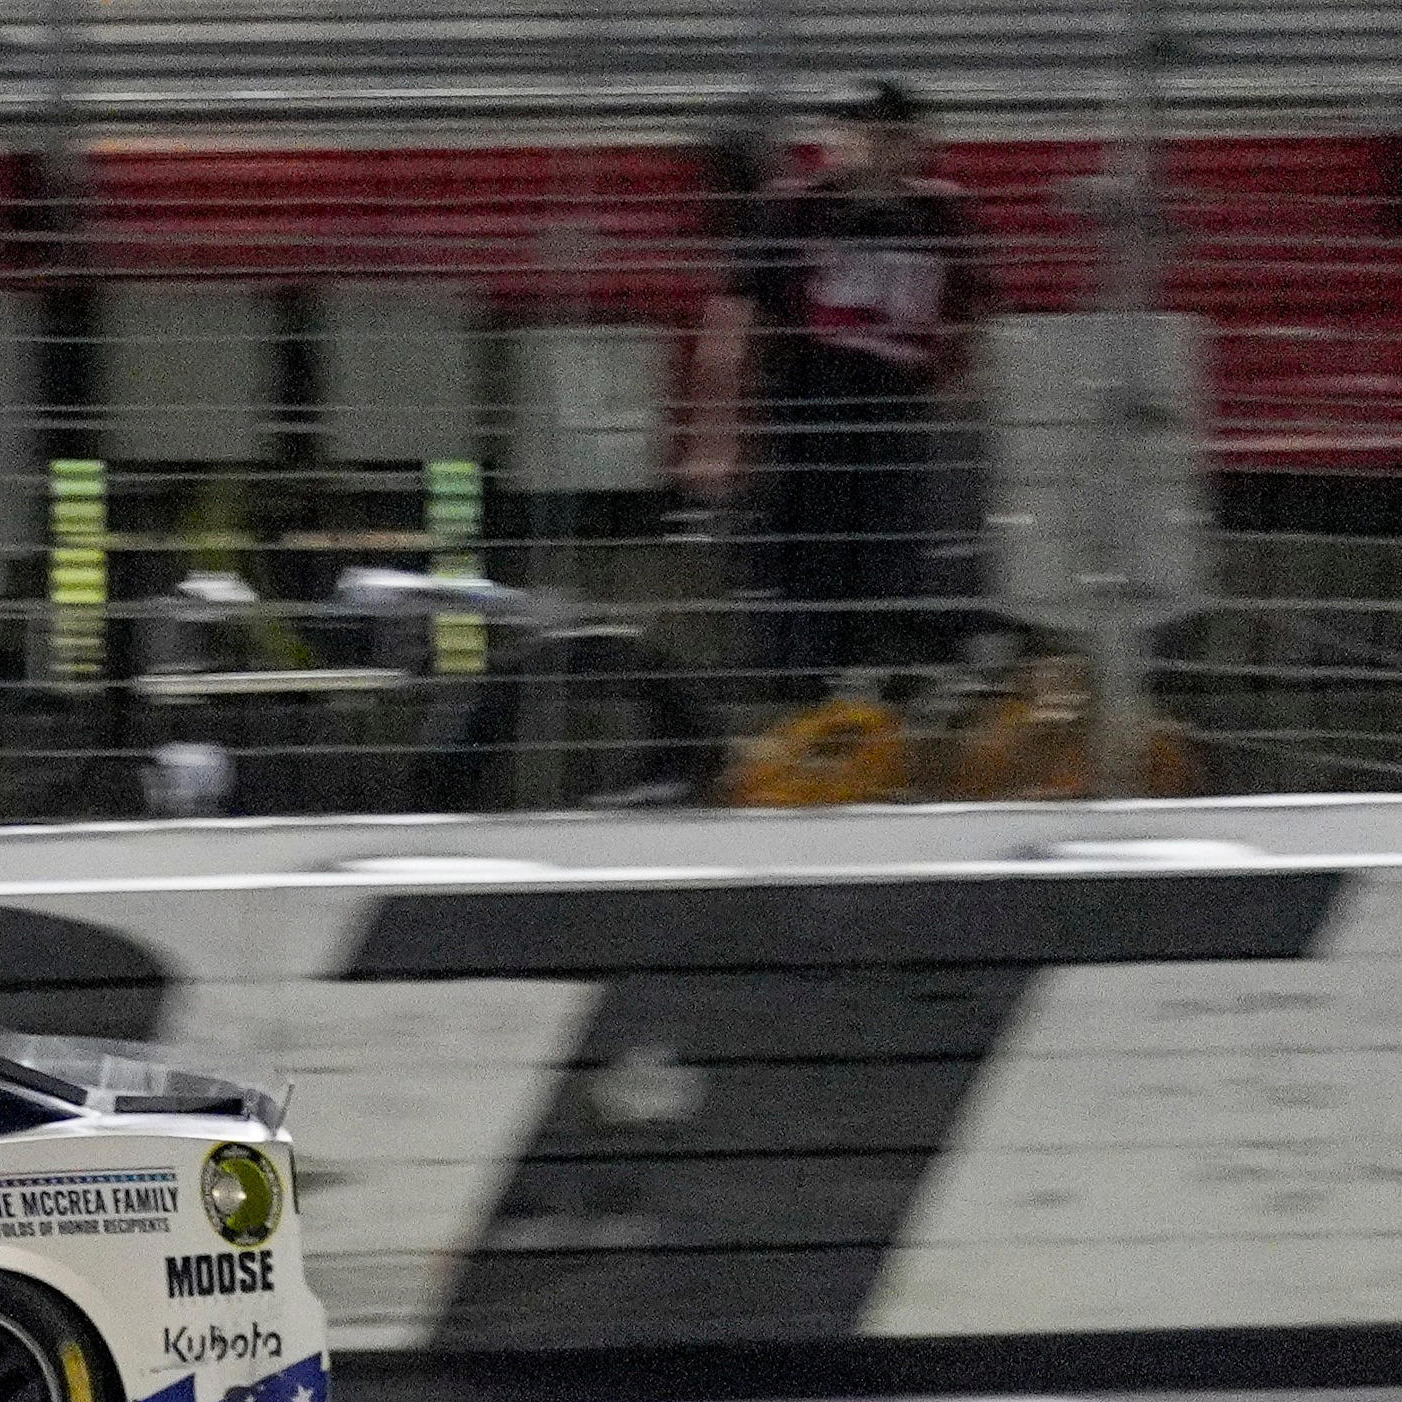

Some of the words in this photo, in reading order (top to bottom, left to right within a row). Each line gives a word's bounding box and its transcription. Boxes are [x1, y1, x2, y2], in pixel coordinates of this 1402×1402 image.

[21, 1189, 107, 1217] MCCREA
[111, 1186, 179, 1214] FAMILY
[165, 1250, 275, 1298] MOOSE
[163, 1321, 282, 1363] Kubota
